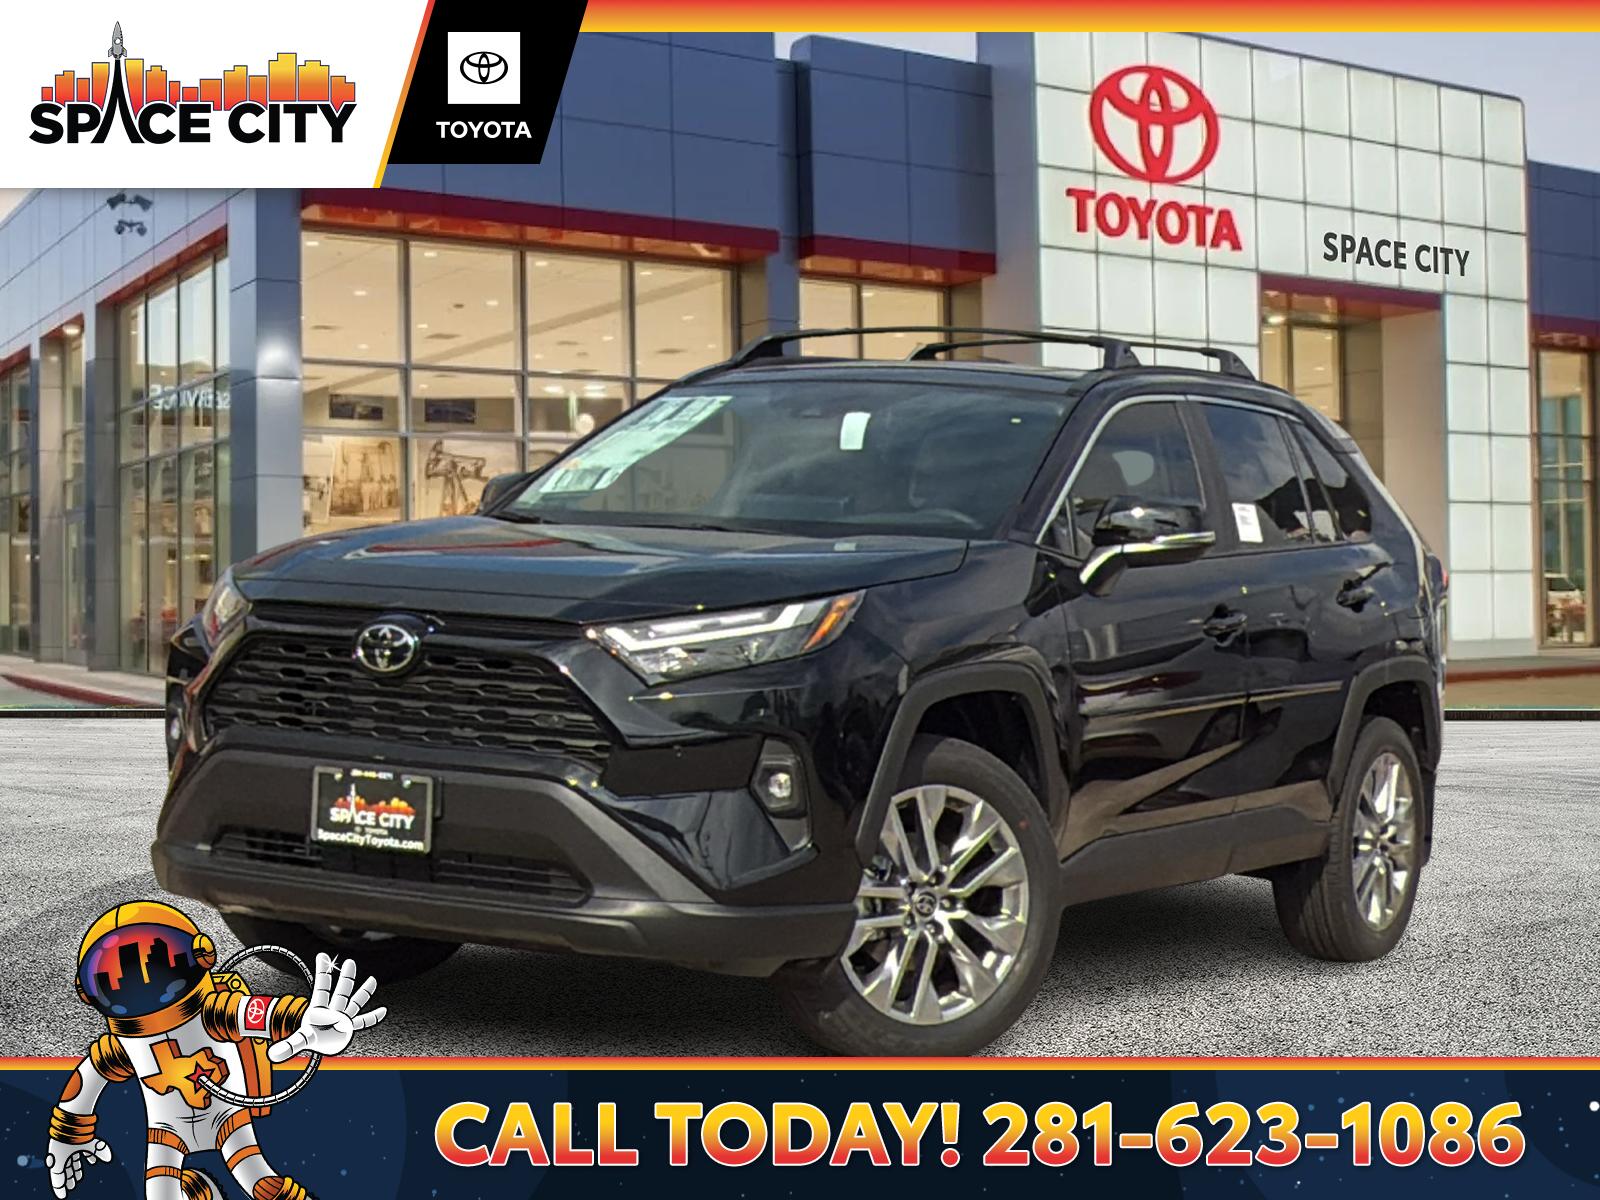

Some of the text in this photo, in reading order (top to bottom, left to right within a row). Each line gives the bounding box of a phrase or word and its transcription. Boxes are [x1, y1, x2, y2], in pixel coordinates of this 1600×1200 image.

[1067, 187, 1242, 251] TOYOTA
[1323, 232, 1470, 277] SPACE CITY
[330, 808, 415, 829] SPACE CITY
